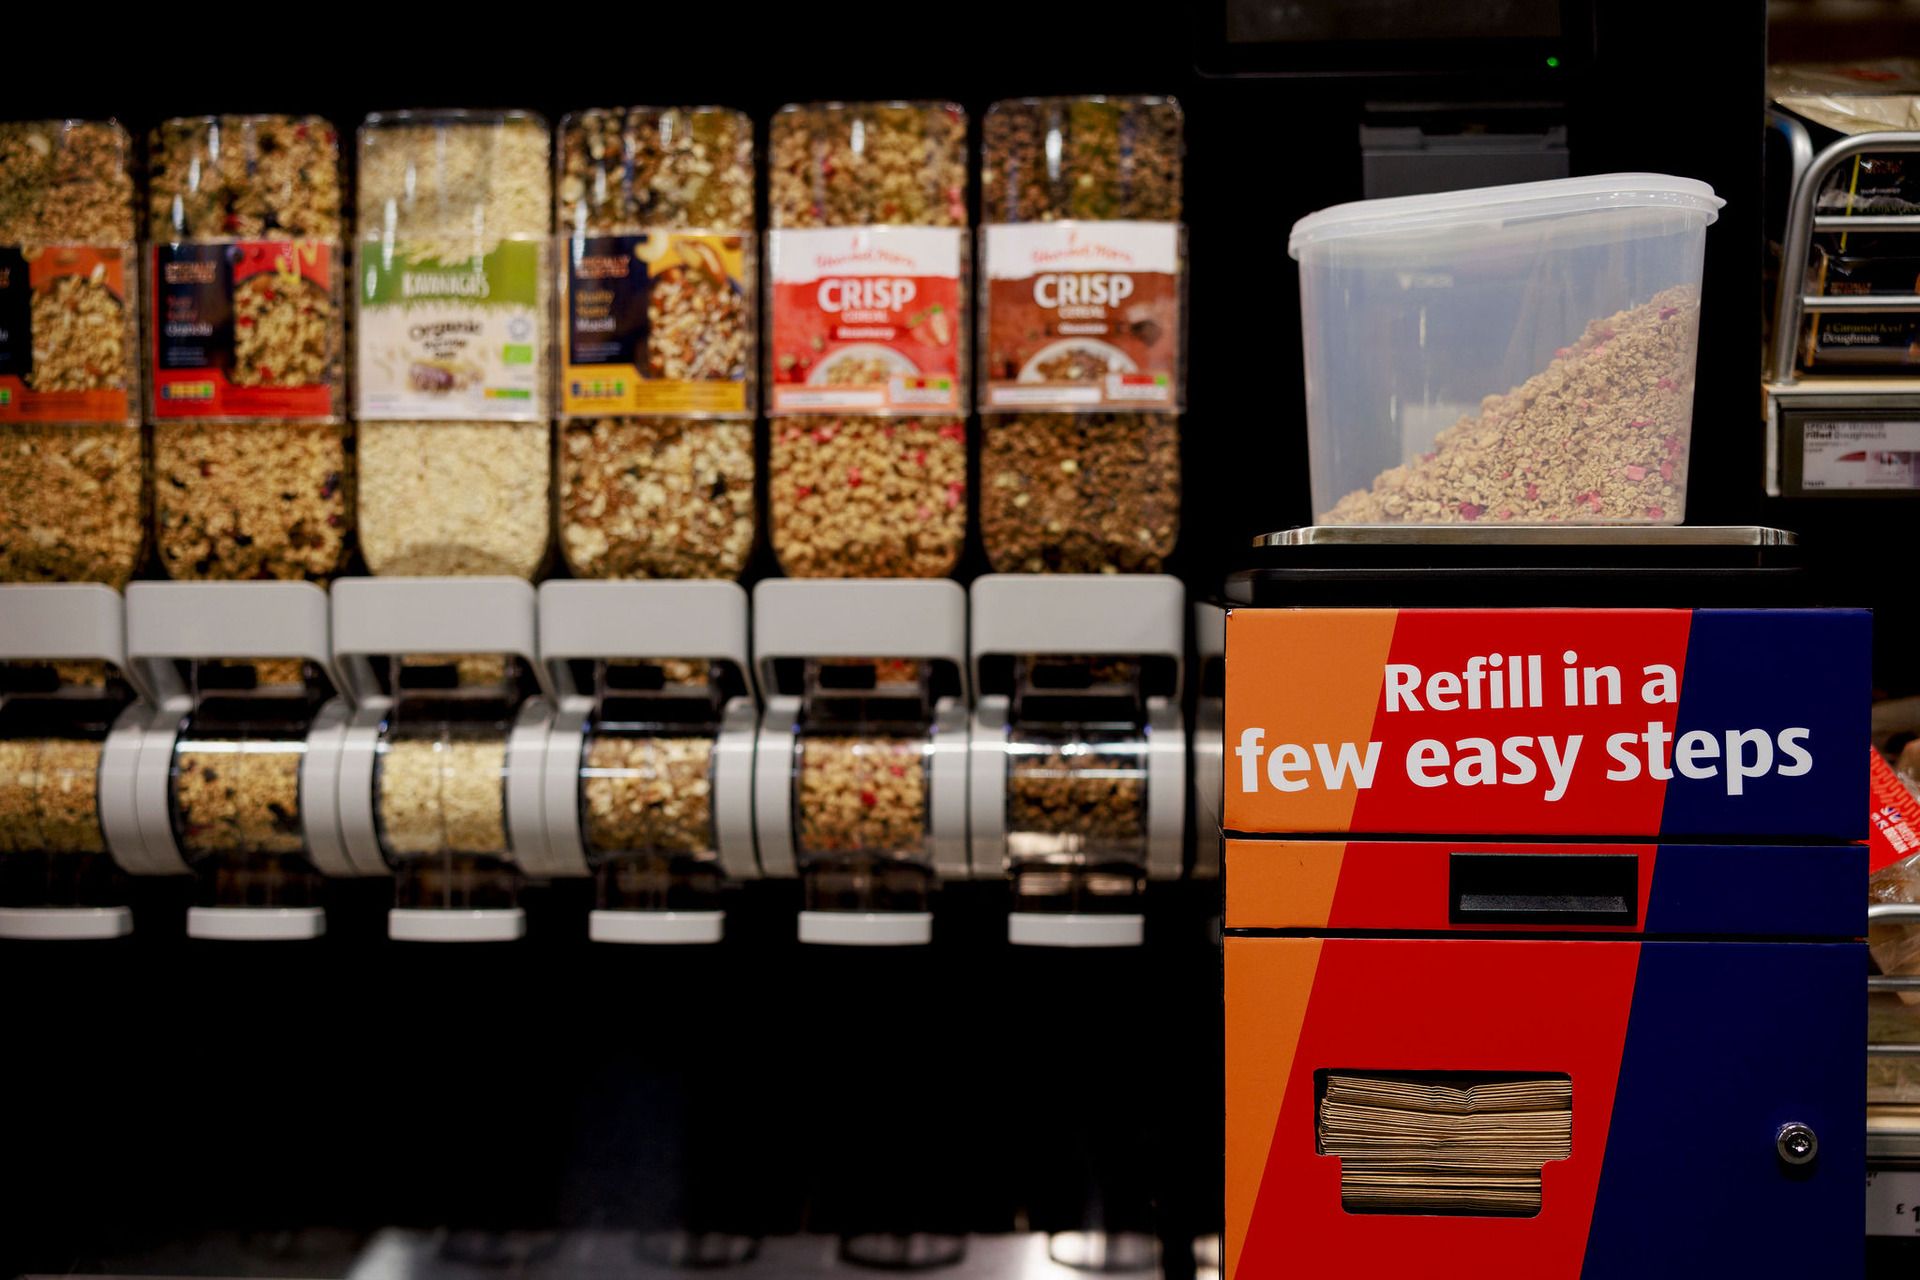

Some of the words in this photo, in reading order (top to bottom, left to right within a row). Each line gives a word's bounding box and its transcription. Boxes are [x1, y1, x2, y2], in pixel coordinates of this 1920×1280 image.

[817, 279, 917, 312] CRISP
[1033, 274, 1134, 309] CRISP
[1823, 332, 1881, 345] Doughnuts
[1385, 652, 1543, 713] Refill
[1562, 650, 1622, 707] in
[1641, 664, 1678, 704] a
[1235, 727, 1383, 793] few
[1405, 734, 1584, 802] easy
[1606, 721, 1814, 796] steps
